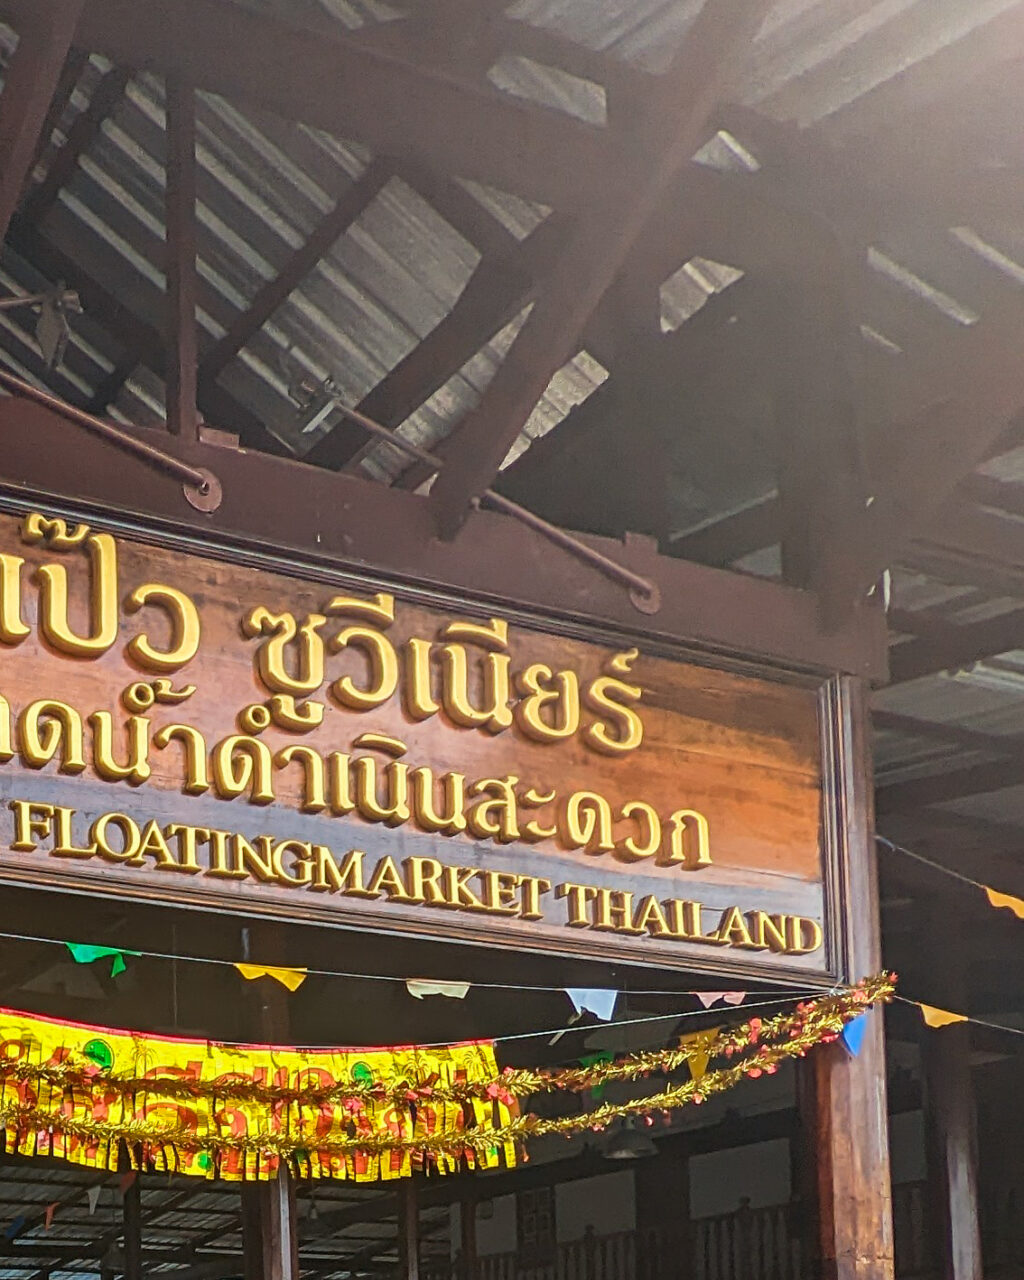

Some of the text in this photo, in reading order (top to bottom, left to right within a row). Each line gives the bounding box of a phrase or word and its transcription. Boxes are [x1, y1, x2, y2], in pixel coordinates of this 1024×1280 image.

[241, 592, 647, 757] ซูวีเนียร์
[10, 798, 551, 922] FLOATINGMARKET
[561, 882, 823, 956] THAILAND
